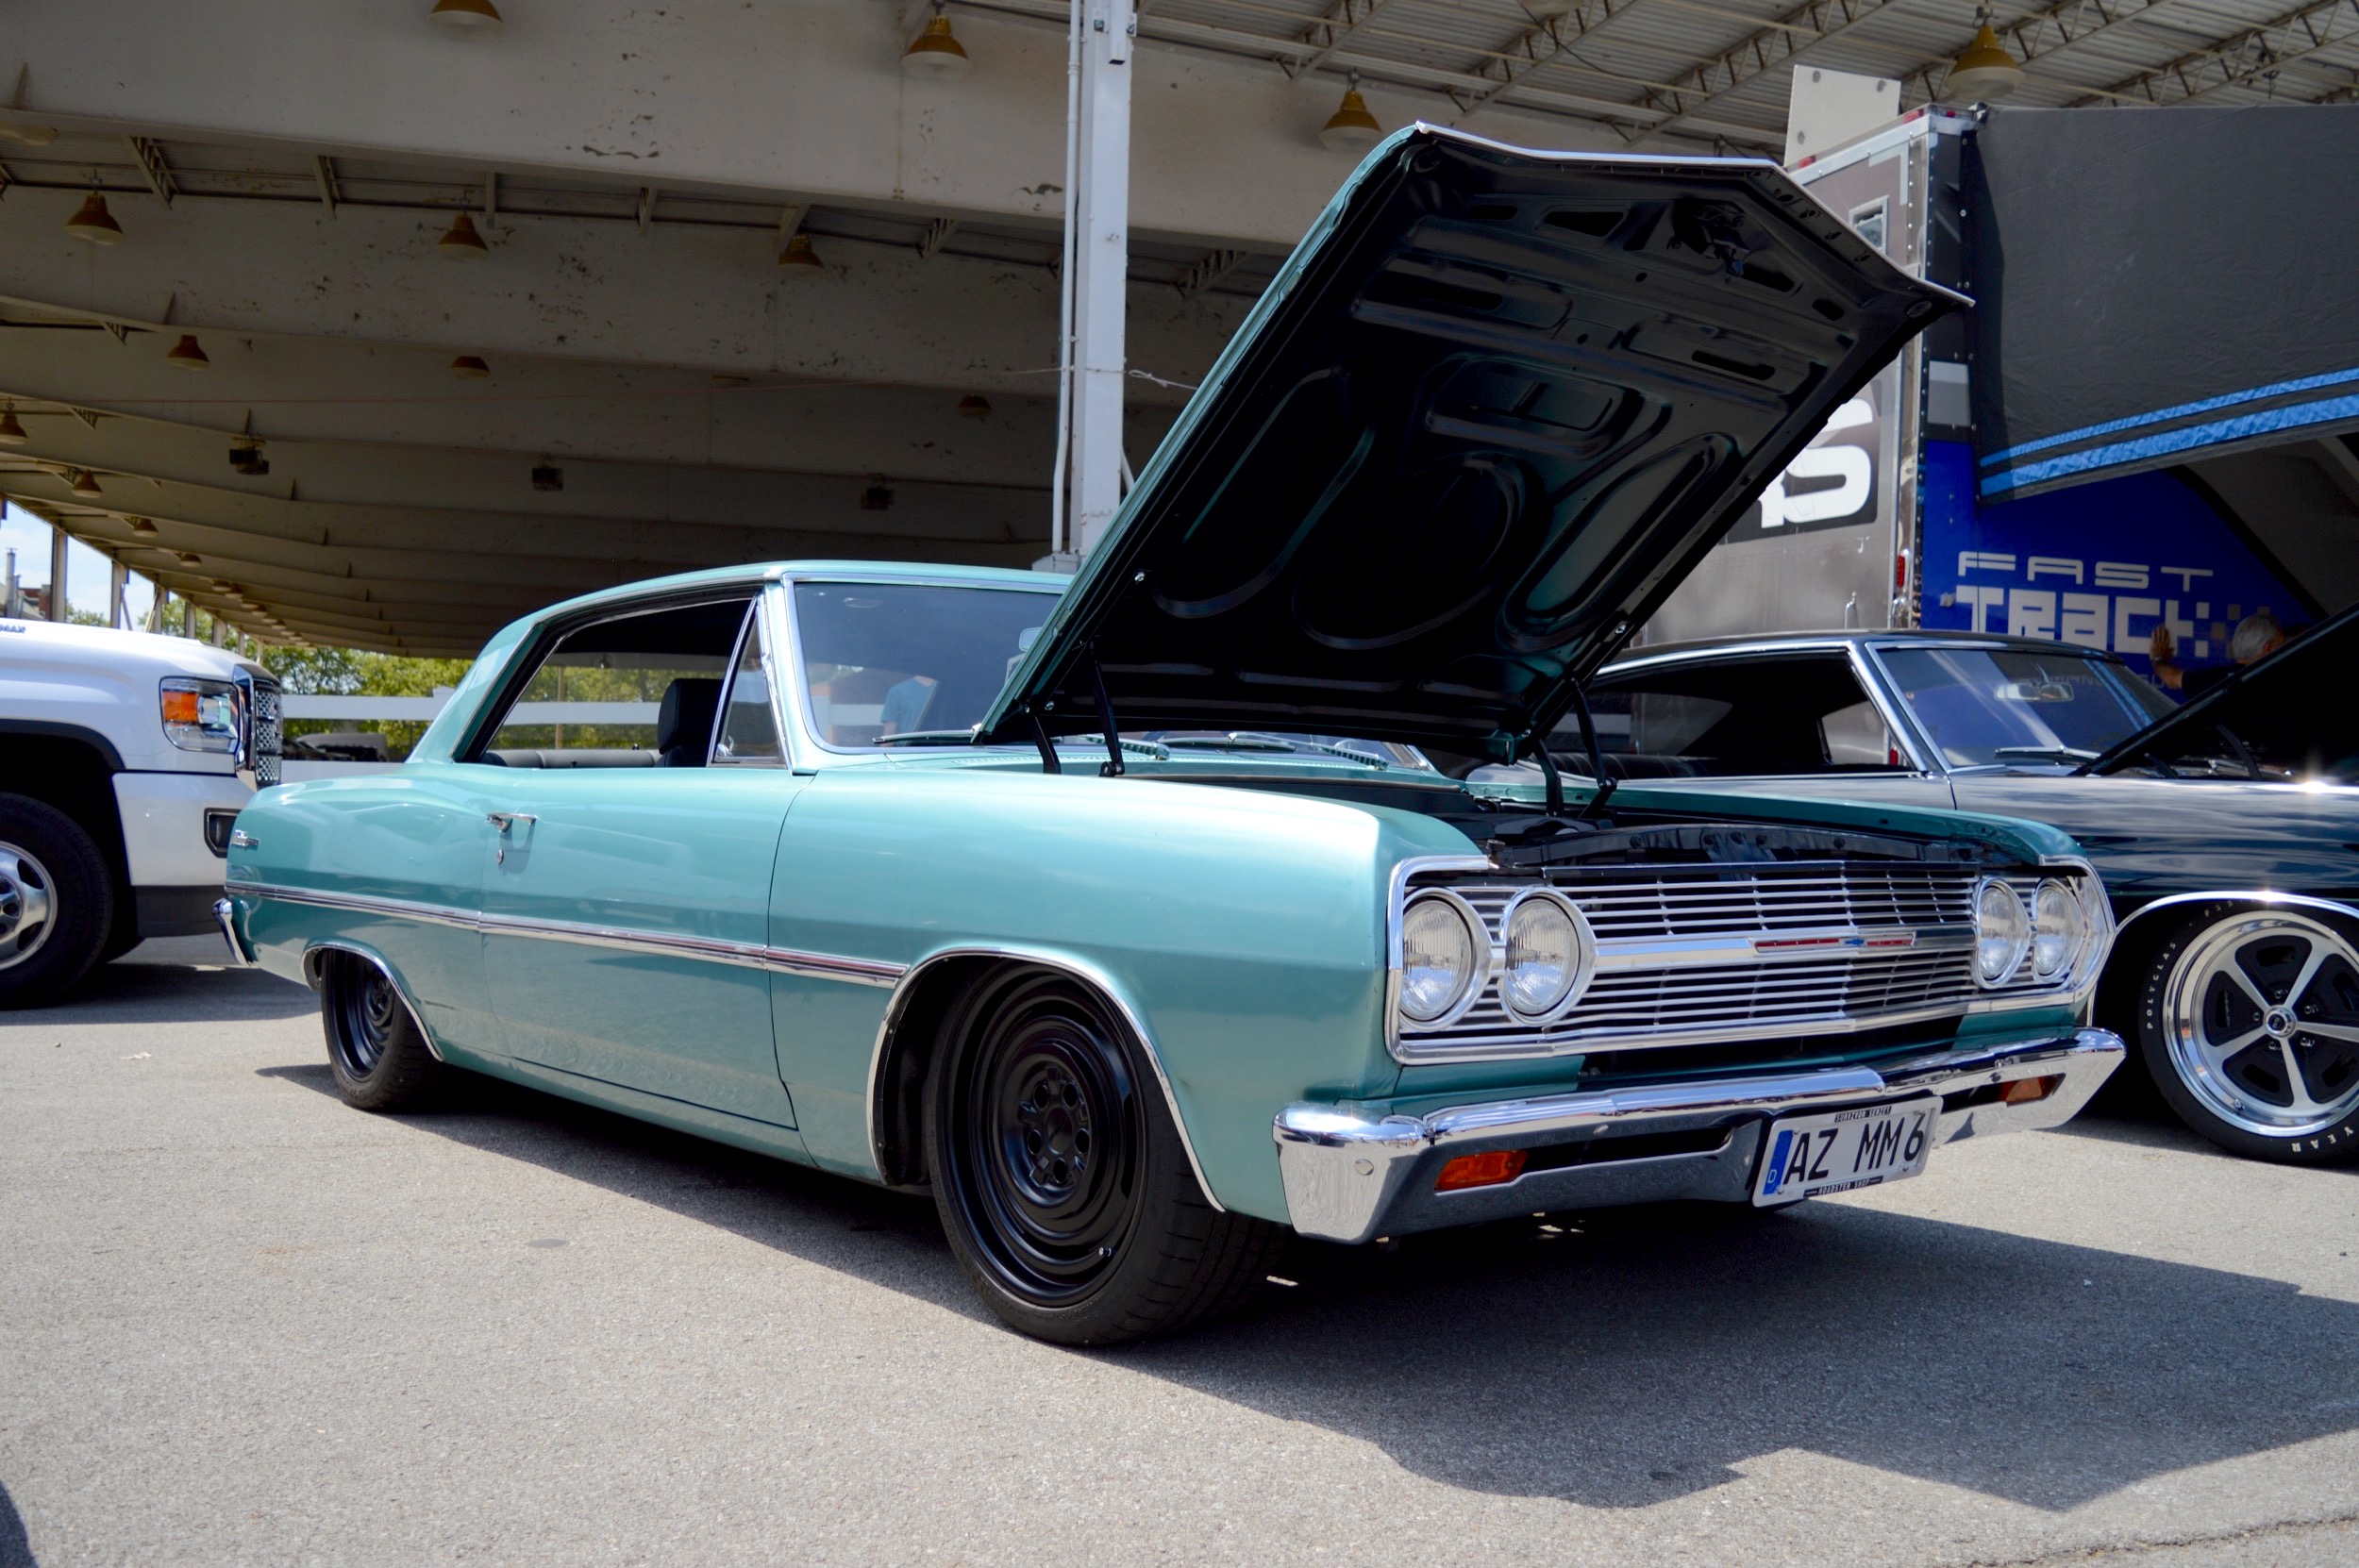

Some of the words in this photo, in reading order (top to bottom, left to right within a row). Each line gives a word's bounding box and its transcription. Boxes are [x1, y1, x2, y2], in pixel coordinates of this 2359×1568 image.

[1958, 551, 2213, 592] FAST
[1766, 1169, 1777, 1184] D
[1782, 1128, 1839, 1185] AZ
[1817, 1182, 1851, 1195] ROADSTER
[1853, 1178, 1870, 1189] SHOP
